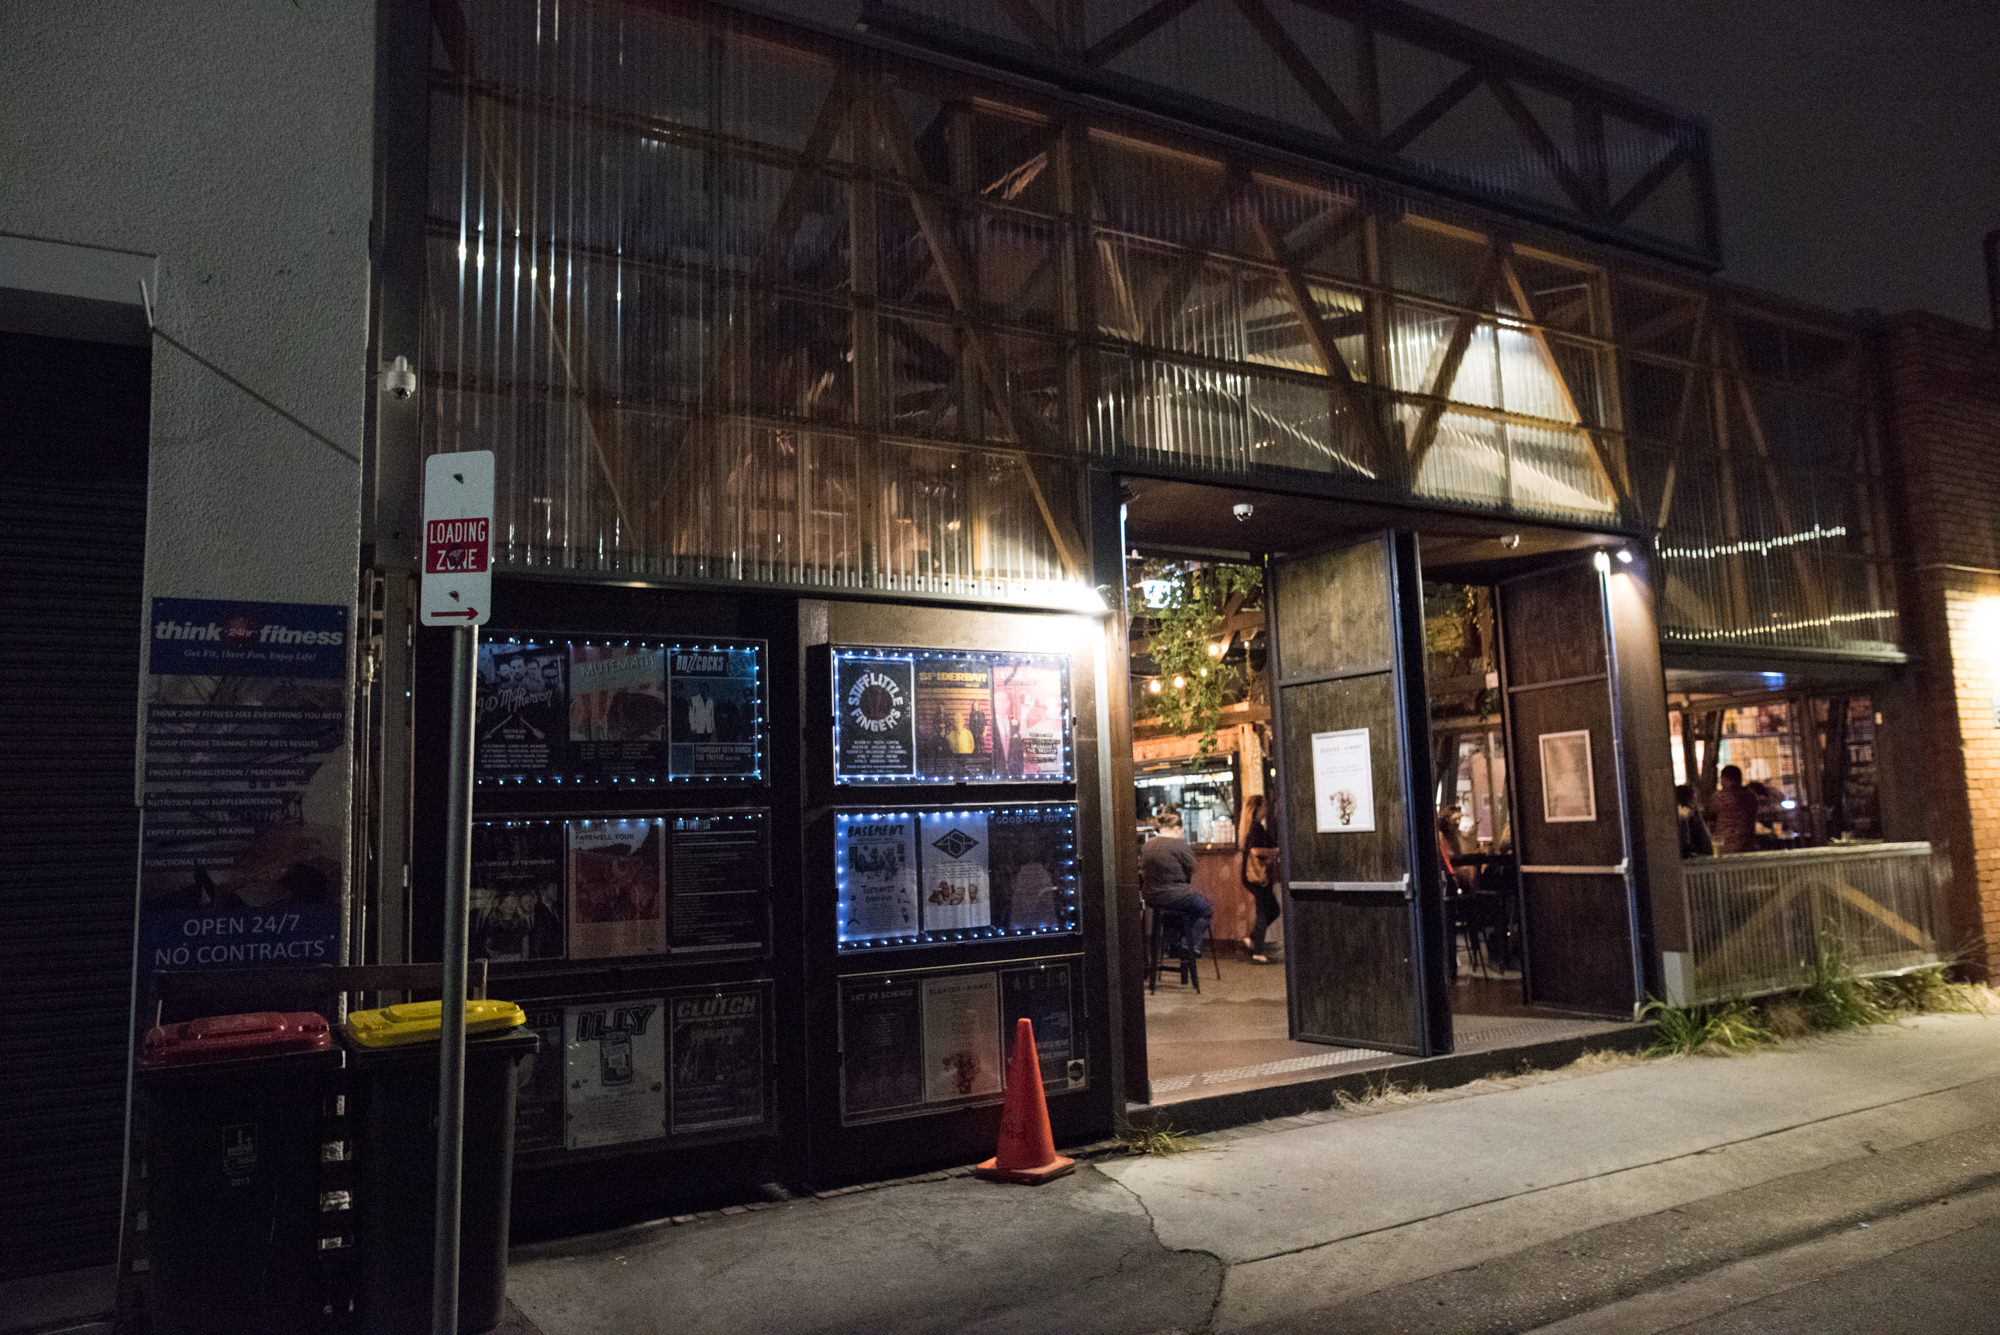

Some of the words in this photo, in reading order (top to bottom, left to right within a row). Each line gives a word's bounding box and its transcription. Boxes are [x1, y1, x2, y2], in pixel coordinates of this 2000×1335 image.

[430, 520, 487, 544] LOADING
[155, 620, 223, 641] think
[259, 624, 344, 645] fitness
[184, 649, 201, 658] Get
[221, 650, 246, 659] Have
[296, 652, 317, 661] Life!
[582, 654, 655, 677] MUTEMATH
[676, 653, 725, 673] BUZZCOCKS
[919, 671, 988, 683] SPIDERBAIT
[848, 673, 872, 707] STIFF
[869, 671, 905, 707] LITTLE
[849, 707, 902, 733] FINGERS
[575, 833, 613, 841] FAREWELL
[615, 832, 635, 840] TOUR
[848, 823, 905, 838] BASEMENT
[183, 917, 245, 936] OPEN
[251, 913, 300, 935] 24/7
[155, 947, 190, 965] NO
[197, 940, 325, 963] CONTRACTS
[880, 988, 914, 999] SCIENCE
[677, 996, 757, 1018] CLUTCH
[577, 1005, 657, 1042] ILLY
